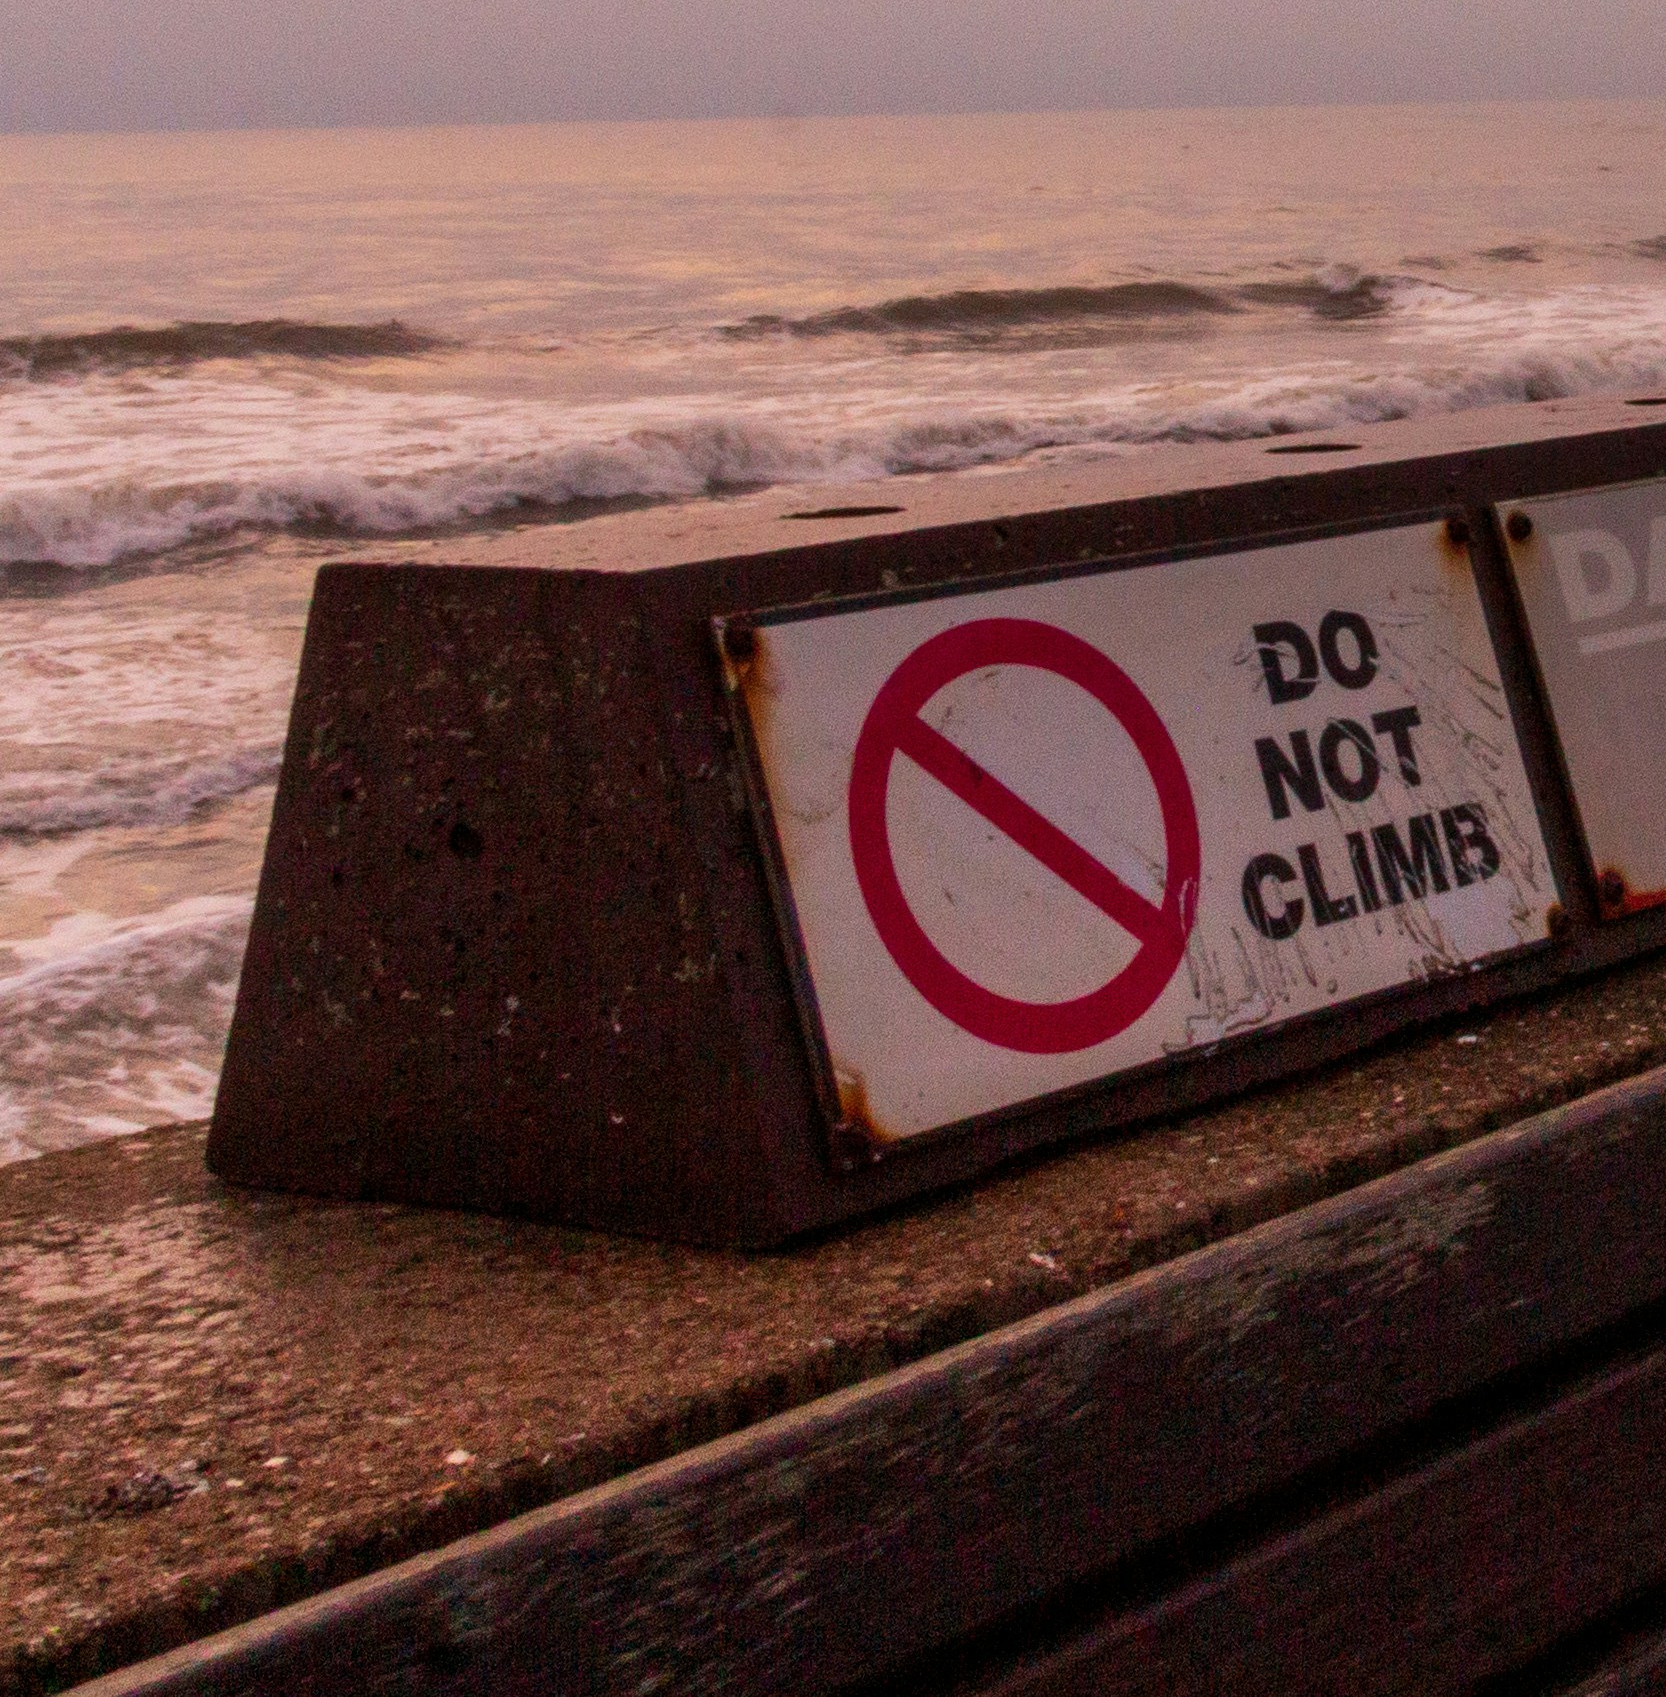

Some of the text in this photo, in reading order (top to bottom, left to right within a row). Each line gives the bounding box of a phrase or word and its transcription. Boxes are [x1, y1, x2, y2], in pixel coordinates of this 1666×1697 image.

[1253, 609, 1380, 705] DO
[1254, 705, 1422, 821] NOT
[1241, 803, 1501, 940] CLIMB
